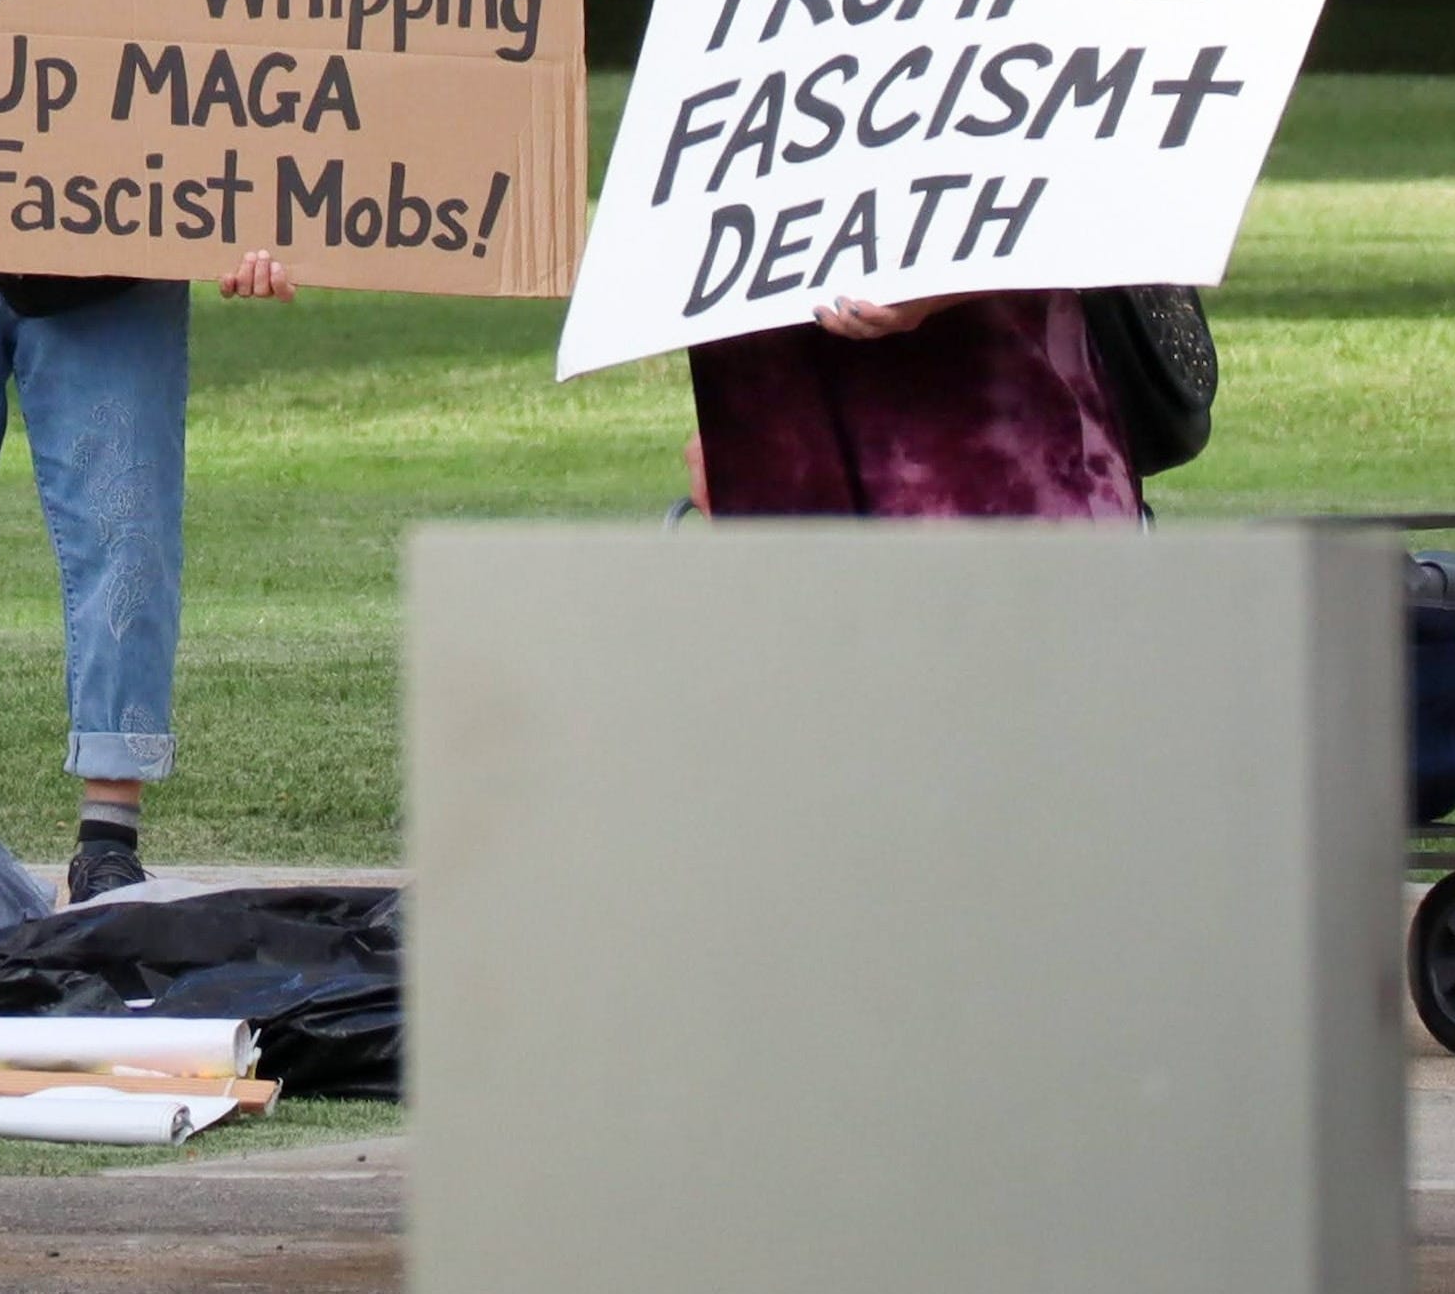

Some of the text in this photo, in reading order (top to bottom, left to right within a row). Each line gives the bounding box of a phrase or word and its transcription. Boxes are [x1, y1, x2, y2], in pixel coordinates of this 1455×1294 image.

[110, 42, 361, 133] MAGA
[275, 153, 512, 259] Mobs!
[682, 173, 1049, 318] DEATH
